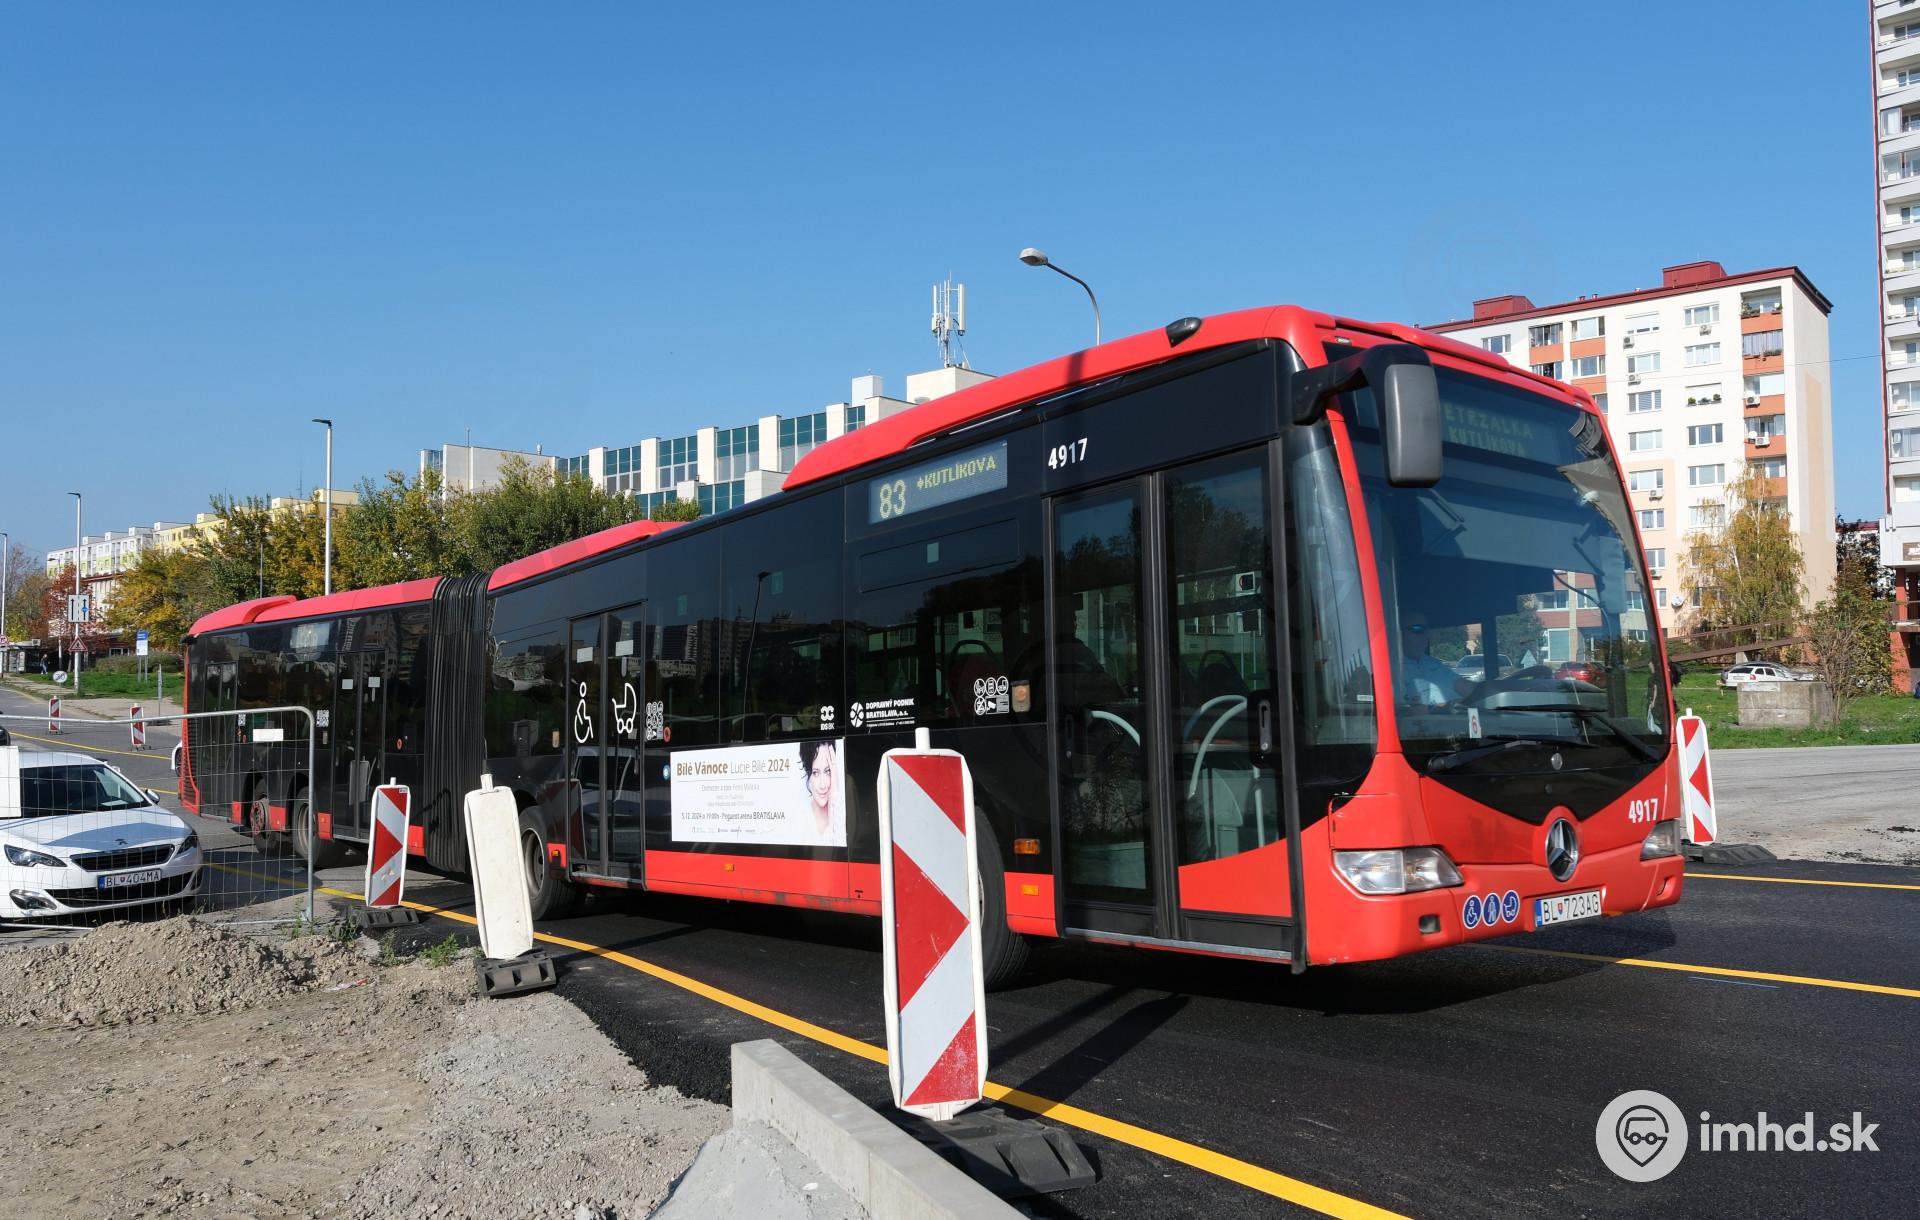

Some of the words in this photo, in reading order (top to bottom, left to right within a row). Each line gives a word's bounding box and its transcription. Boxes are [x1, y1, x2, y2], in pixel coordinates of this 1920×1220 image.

[1443, 402, 1533, 439] ETRZALKA
[1048, 437, 1088, 470] 4917
[879, 479, 907, 519] 83
[865, 698, 893, 710] DOPRAVNÝ
[893, 698, 915, 707] PODNIK
[676, 762, 693, 776] Bílé
[694, 761, 728, 776] Vánoce
[730, 761, 750, 774] Lucie
[767, 758, 790, 772] 2024
[753, 811, 786, 820] BRATISLAVA
[1628, 798, 1659, 823] 4917
